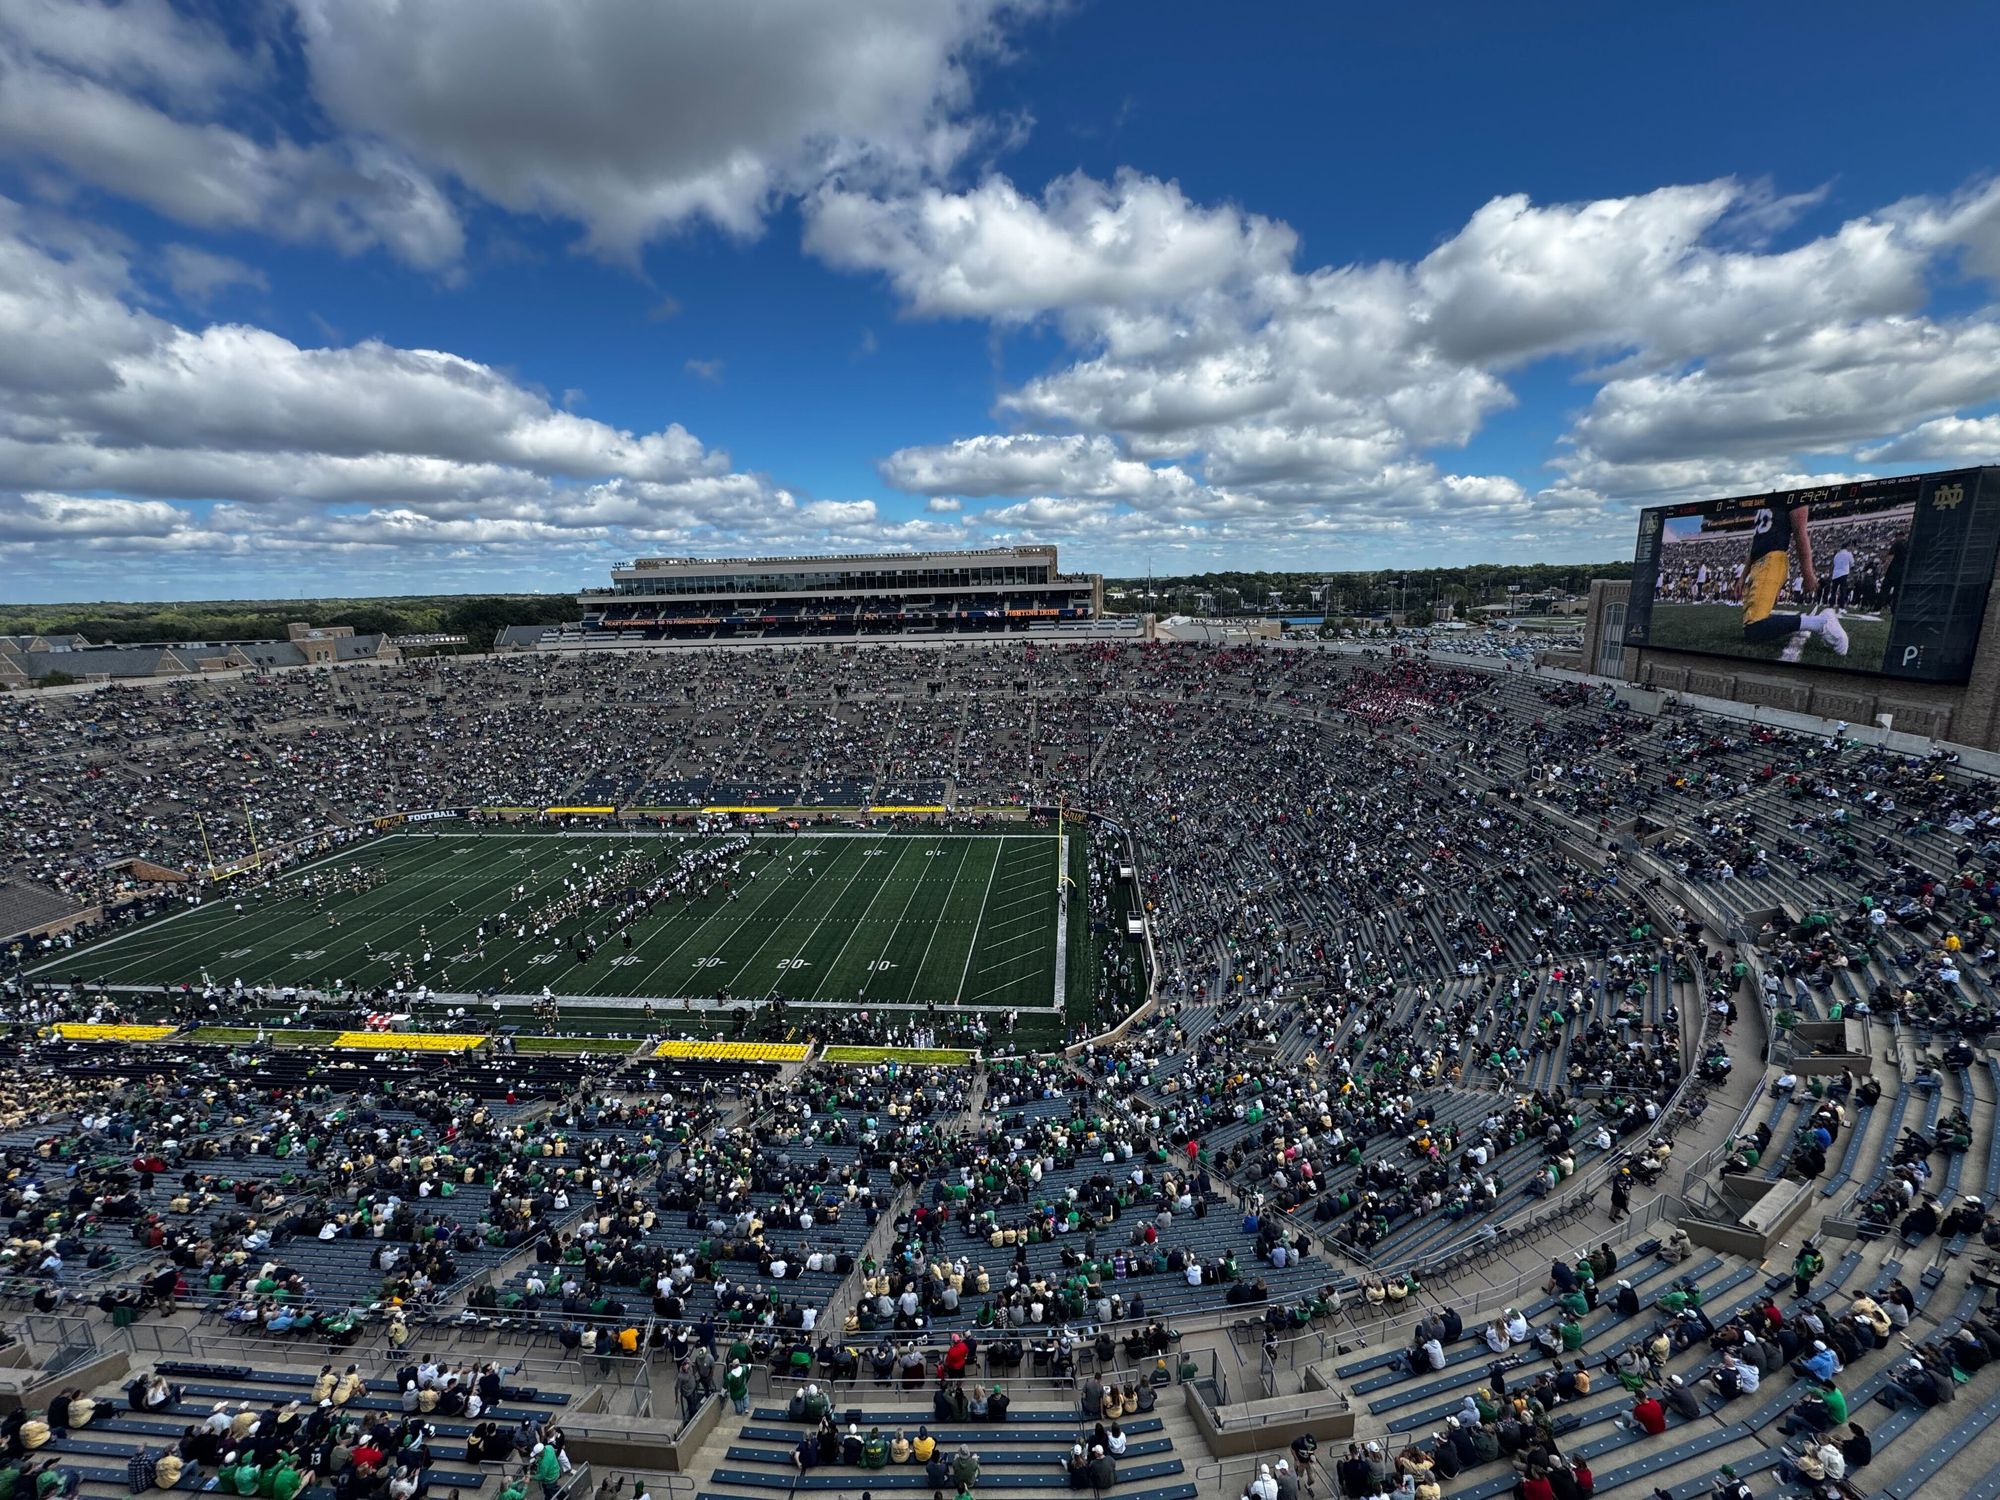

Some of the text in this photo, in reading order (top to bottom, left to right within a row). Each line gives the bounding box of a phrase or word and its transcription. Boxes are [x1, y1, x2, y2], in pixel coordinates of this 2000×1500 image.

[1787, 493, 1795, 504] 0
[1716, 502, 1723, 512] 0
[1004, 609, 1038, 617] FIGHTING
[407, 810, 458, 822] FOOTBALL
[528, 954, 559, 965] 50
[610, 955, 638, 966] 40
[692, 957, 721, 968] 30
[776, 958, 805, 969] 20
[867, 960, 891, 971] 10
[311, 1453, 321, 1466] 13
